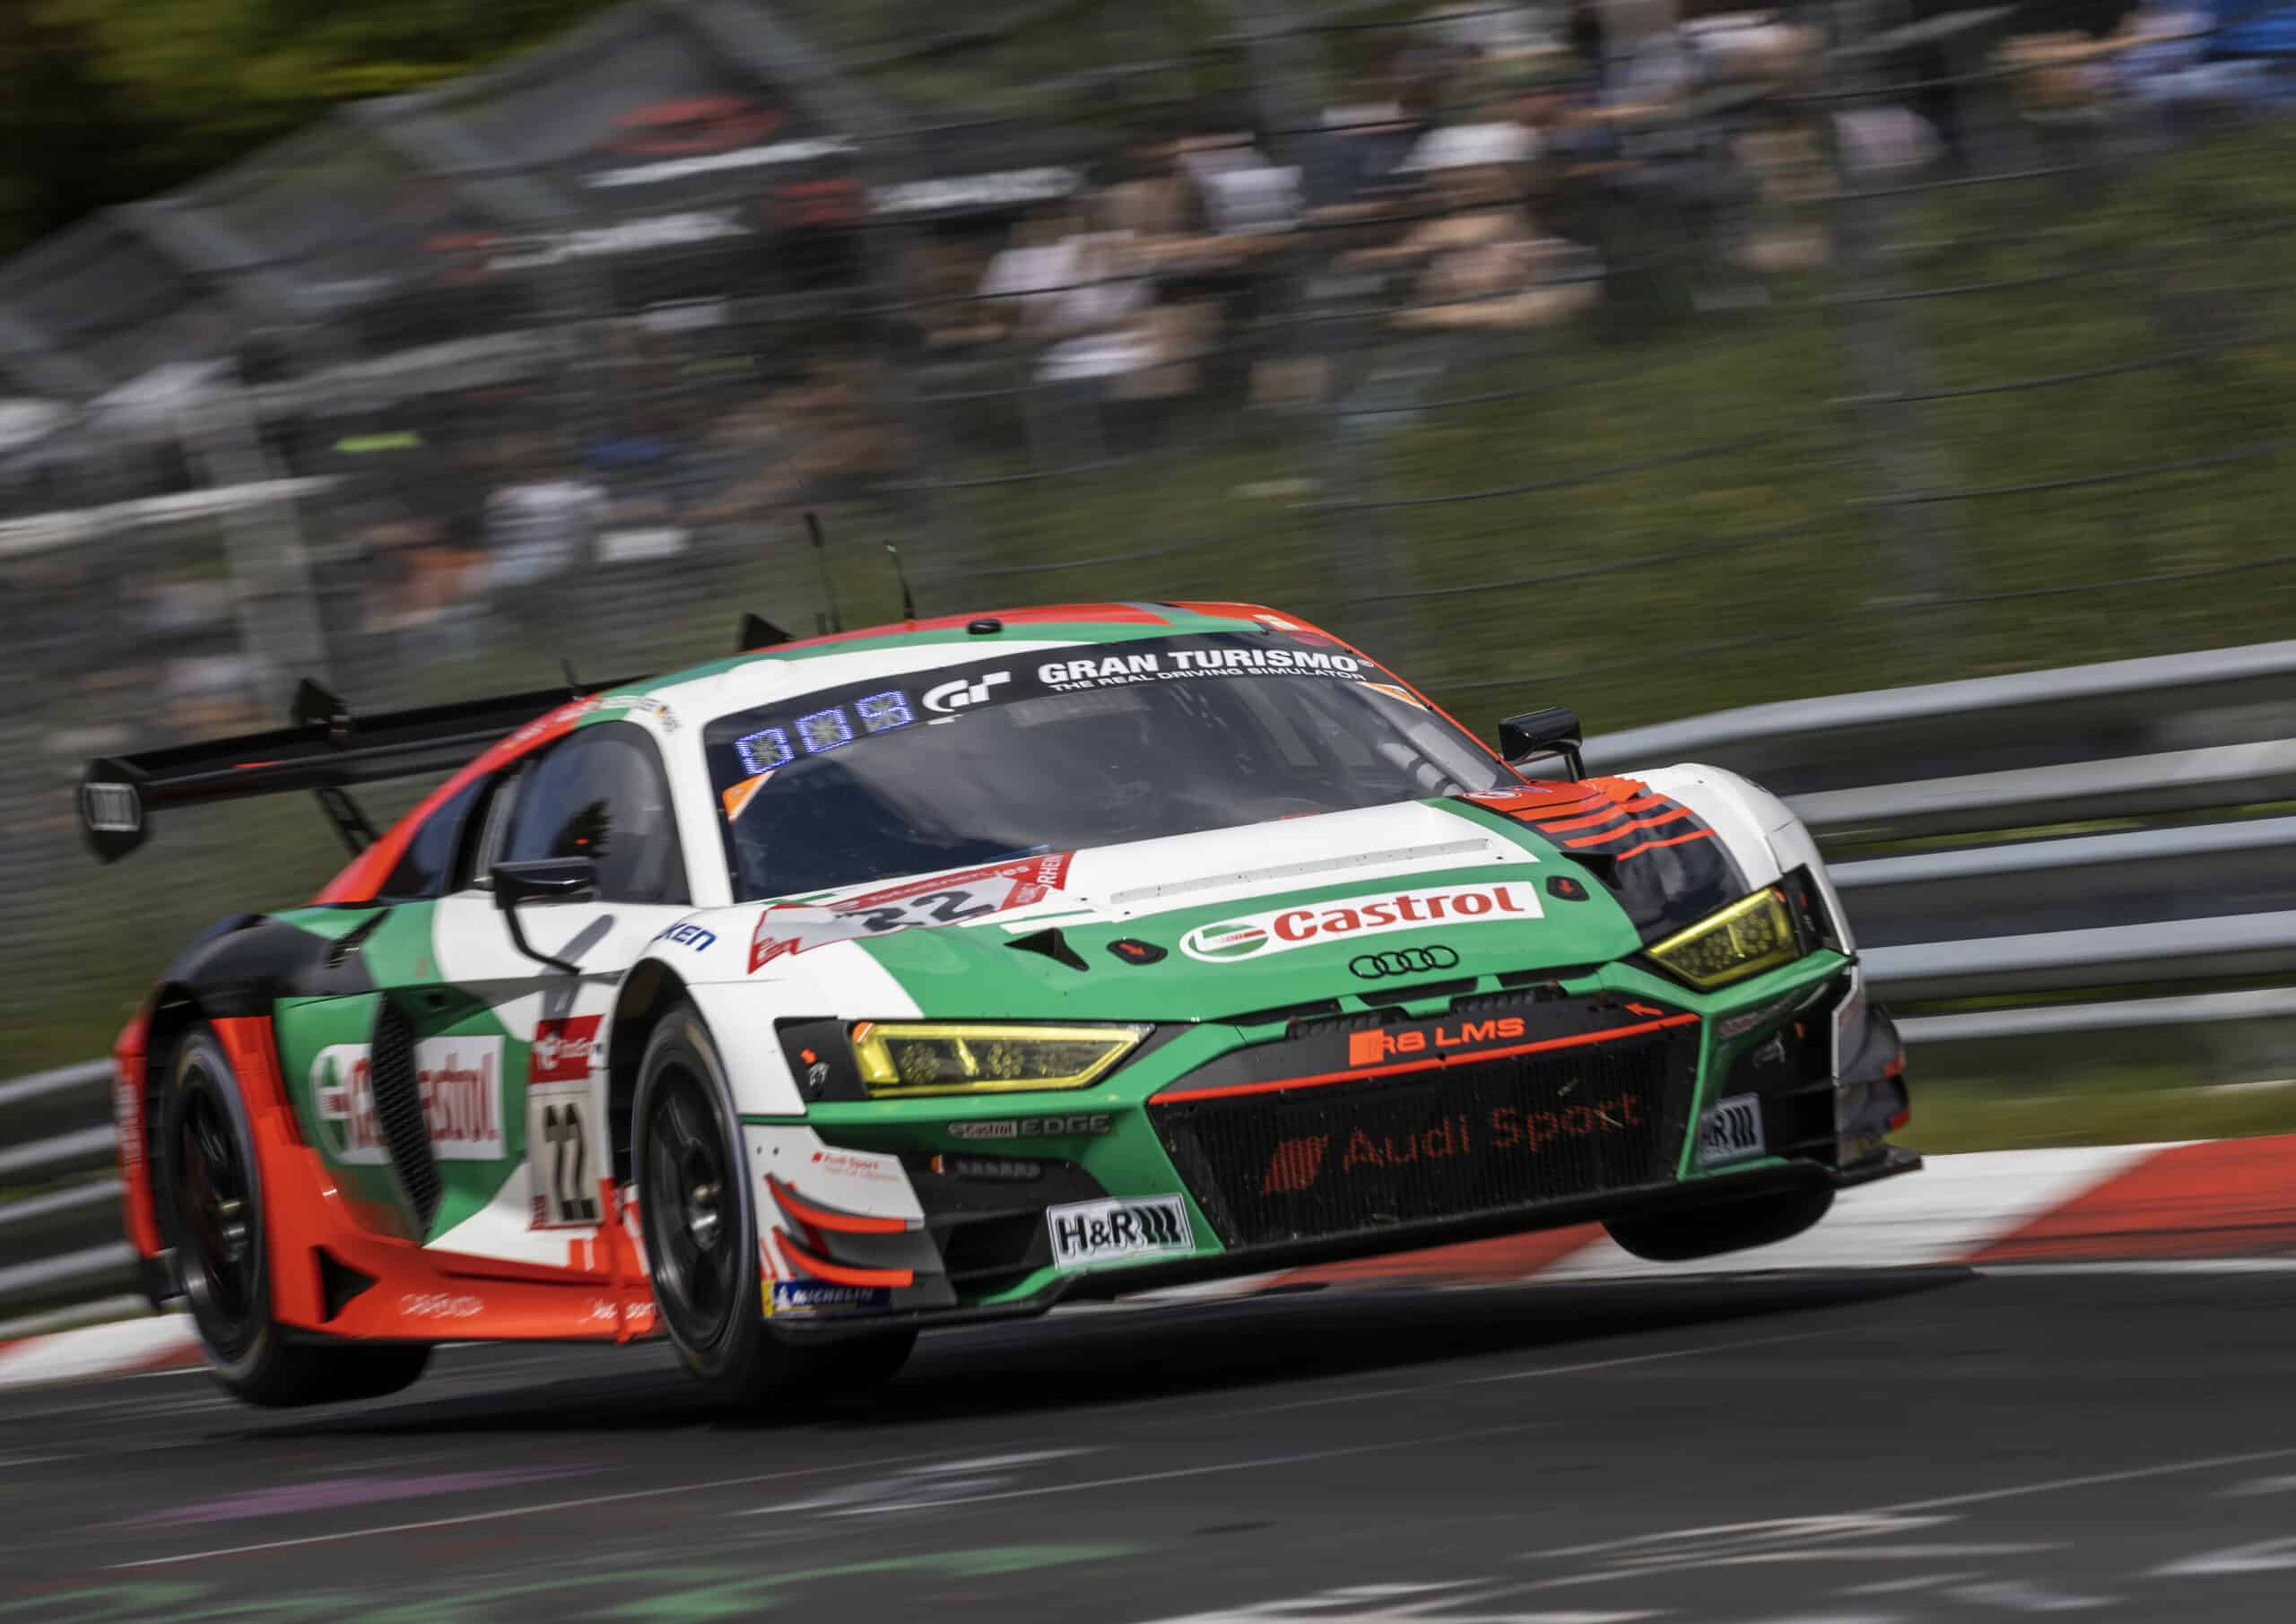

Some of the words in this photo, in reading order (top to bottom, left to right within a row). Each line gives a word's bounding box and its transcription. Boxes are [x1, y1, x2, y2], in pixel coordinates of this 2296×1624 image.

[1038, 653, 1160, 684] GRAN
[1048, 680, 1095, 692] THE
[1098, 674, 1156, 687] REAL
[1157, 667, 1244, 680] DRIVING
[1248, 667, 1367, 682] SIMULATOR
[1273, 886, 1526, 942] Castrol
[1382, 1029, 1427, 1055] R8
[1435, 1017, 1526, 1047] LMS
[1021, 1113, 1110, 1135] EDGE
[1343, 1111, 1471, 1172] Audi
[1490, 1091, 1645, 1154] Sport
[1056, 1209, 1139, 1253] H&R
